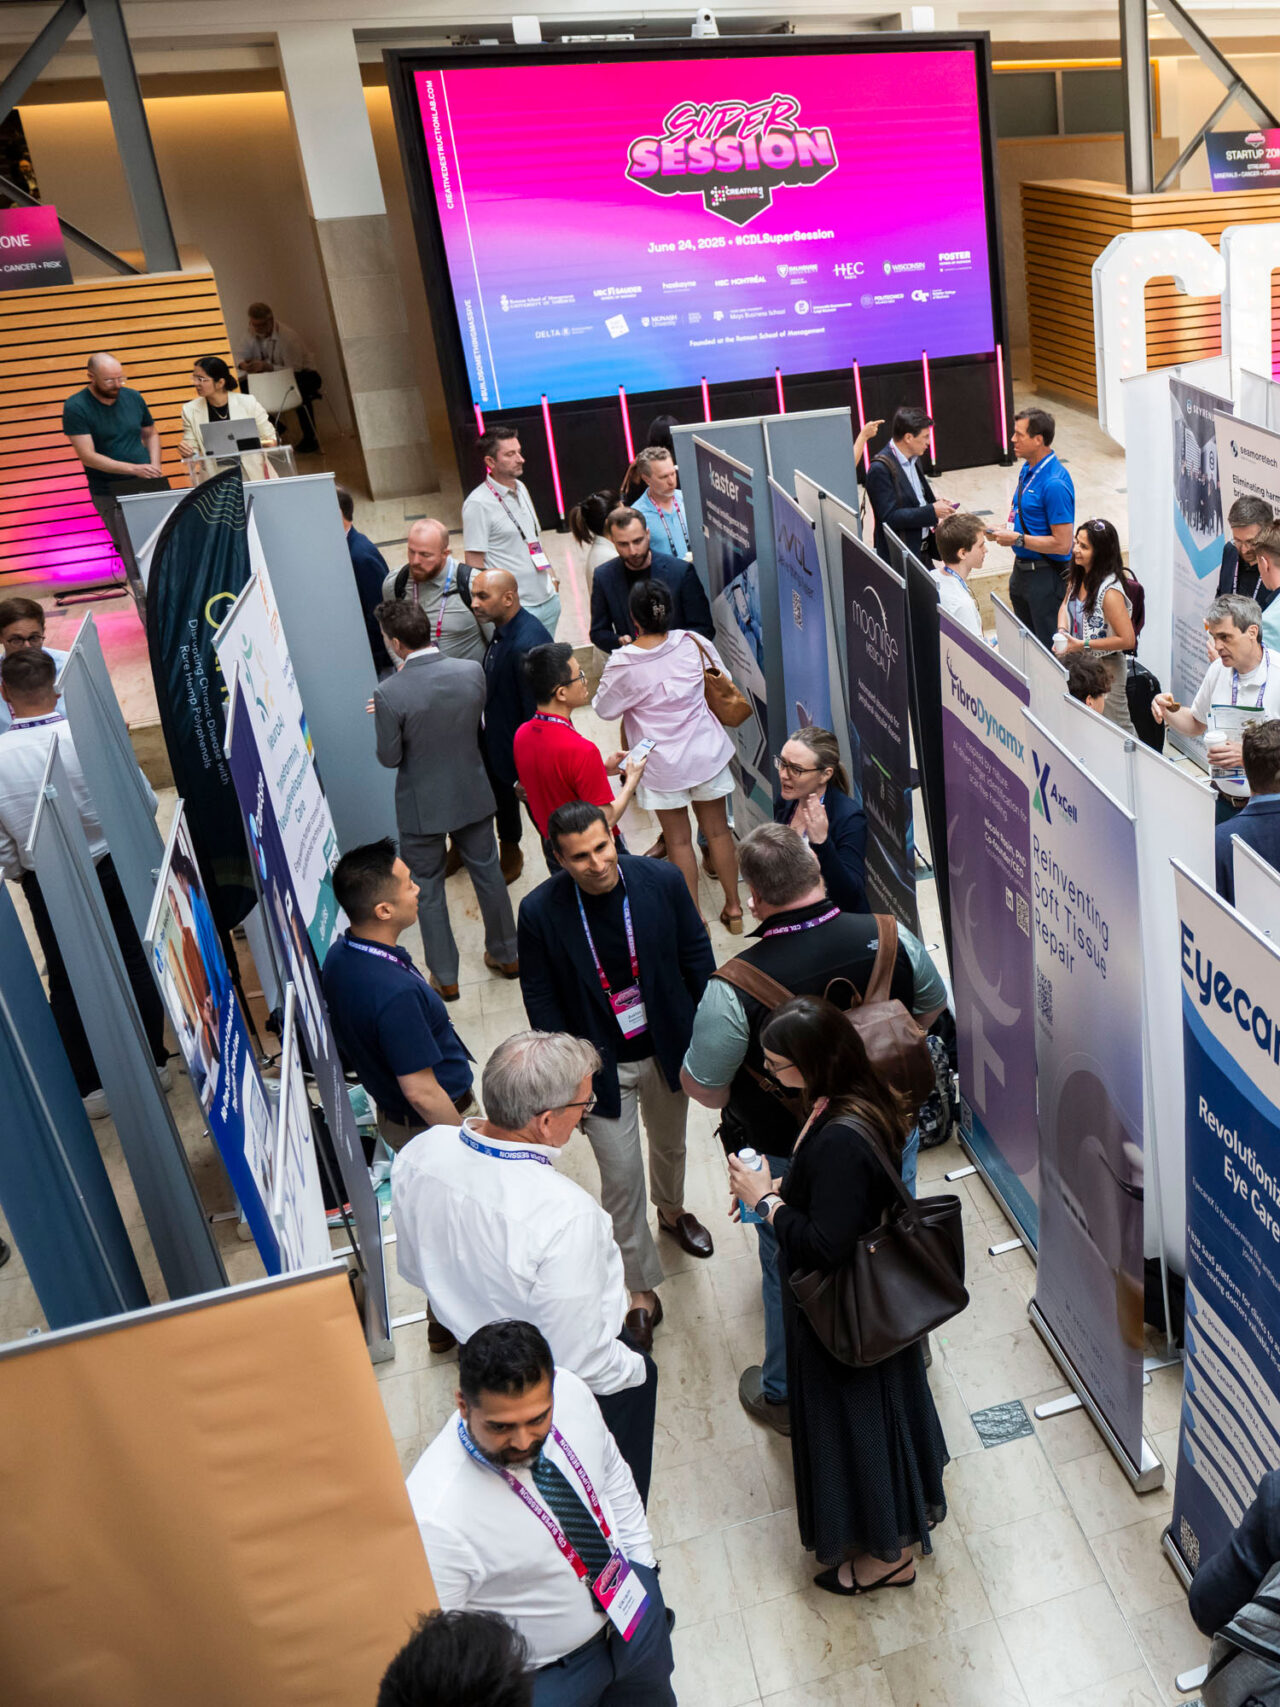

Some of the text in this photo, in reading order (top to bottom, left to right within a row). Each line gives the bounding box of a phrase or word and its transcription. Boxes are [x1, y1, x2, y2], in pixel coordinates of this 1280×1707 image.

[662, 100, 796, 146] SUPER
[426, 80, 454, 209] CREATIVEDESTRUCTIONLAB.COM
[629, 131, 835, 178] SESSION
[1225, 149, 1265, 161] STARTUP
[0, 234, 31, 248] ONE
[648, 229, 835, 254] June 24, 2025 #CDLSuperSession
[939, 251, 971, 262] FOSTER
[4, 260, 62, 273] CANCER RISK
[833, 261, 865, 277] HEC
[615, 285, 642, 295] SAUDER
[662, 280, 697, 289] haskayne
[651, 314, 678, 323] MONASH
[747, 308, 787, 319] Business School
[535, 330, 561, 340] DELTA
[689, 337, 716, 348] Founded
[1239, 446, 1279, 469] seamoretech
[708, 461, 740, 504] kaster
[1232, 474, 1266, 497] Eliminating
[188, 618, 230, 786] Disrupting Chronic Disease with
[185, 670, 211, 770] Hemp Polyphenols
[950, 674, 1025, 764] FibroDynamx
[1051, 783, 1078, 824] AxCell
[1033, 833, 1109, 952] Reinventing
[1034, 871, 1107, 980] Soft Tissue
[1034, 909, 1076, 975] Repair
[499, 1150, 530, 1159] SESSION
[1223, 1155, 1280, 1243] Eye Care
[1219, 1209, 1254, 1254] transforming
[1201, 1244, 1216, 1266] SaaS
[1215, 1263, 1242, 1298] platform
[1241, 1291, 1251, 1308] for
[1250, 1306, 1268, 1335] clinics
[1224, 1290, 1248, 1322] doctors
[1216, 1366, 1236, 1397] Canada
[560, 1438, 599, 1508] SESSION SUPER CDL
[519, 1487, 542, 1518] SESSION
[540, 1511, 558, 1536] SUPER
[555, 1531, 567, 1549] CDL
